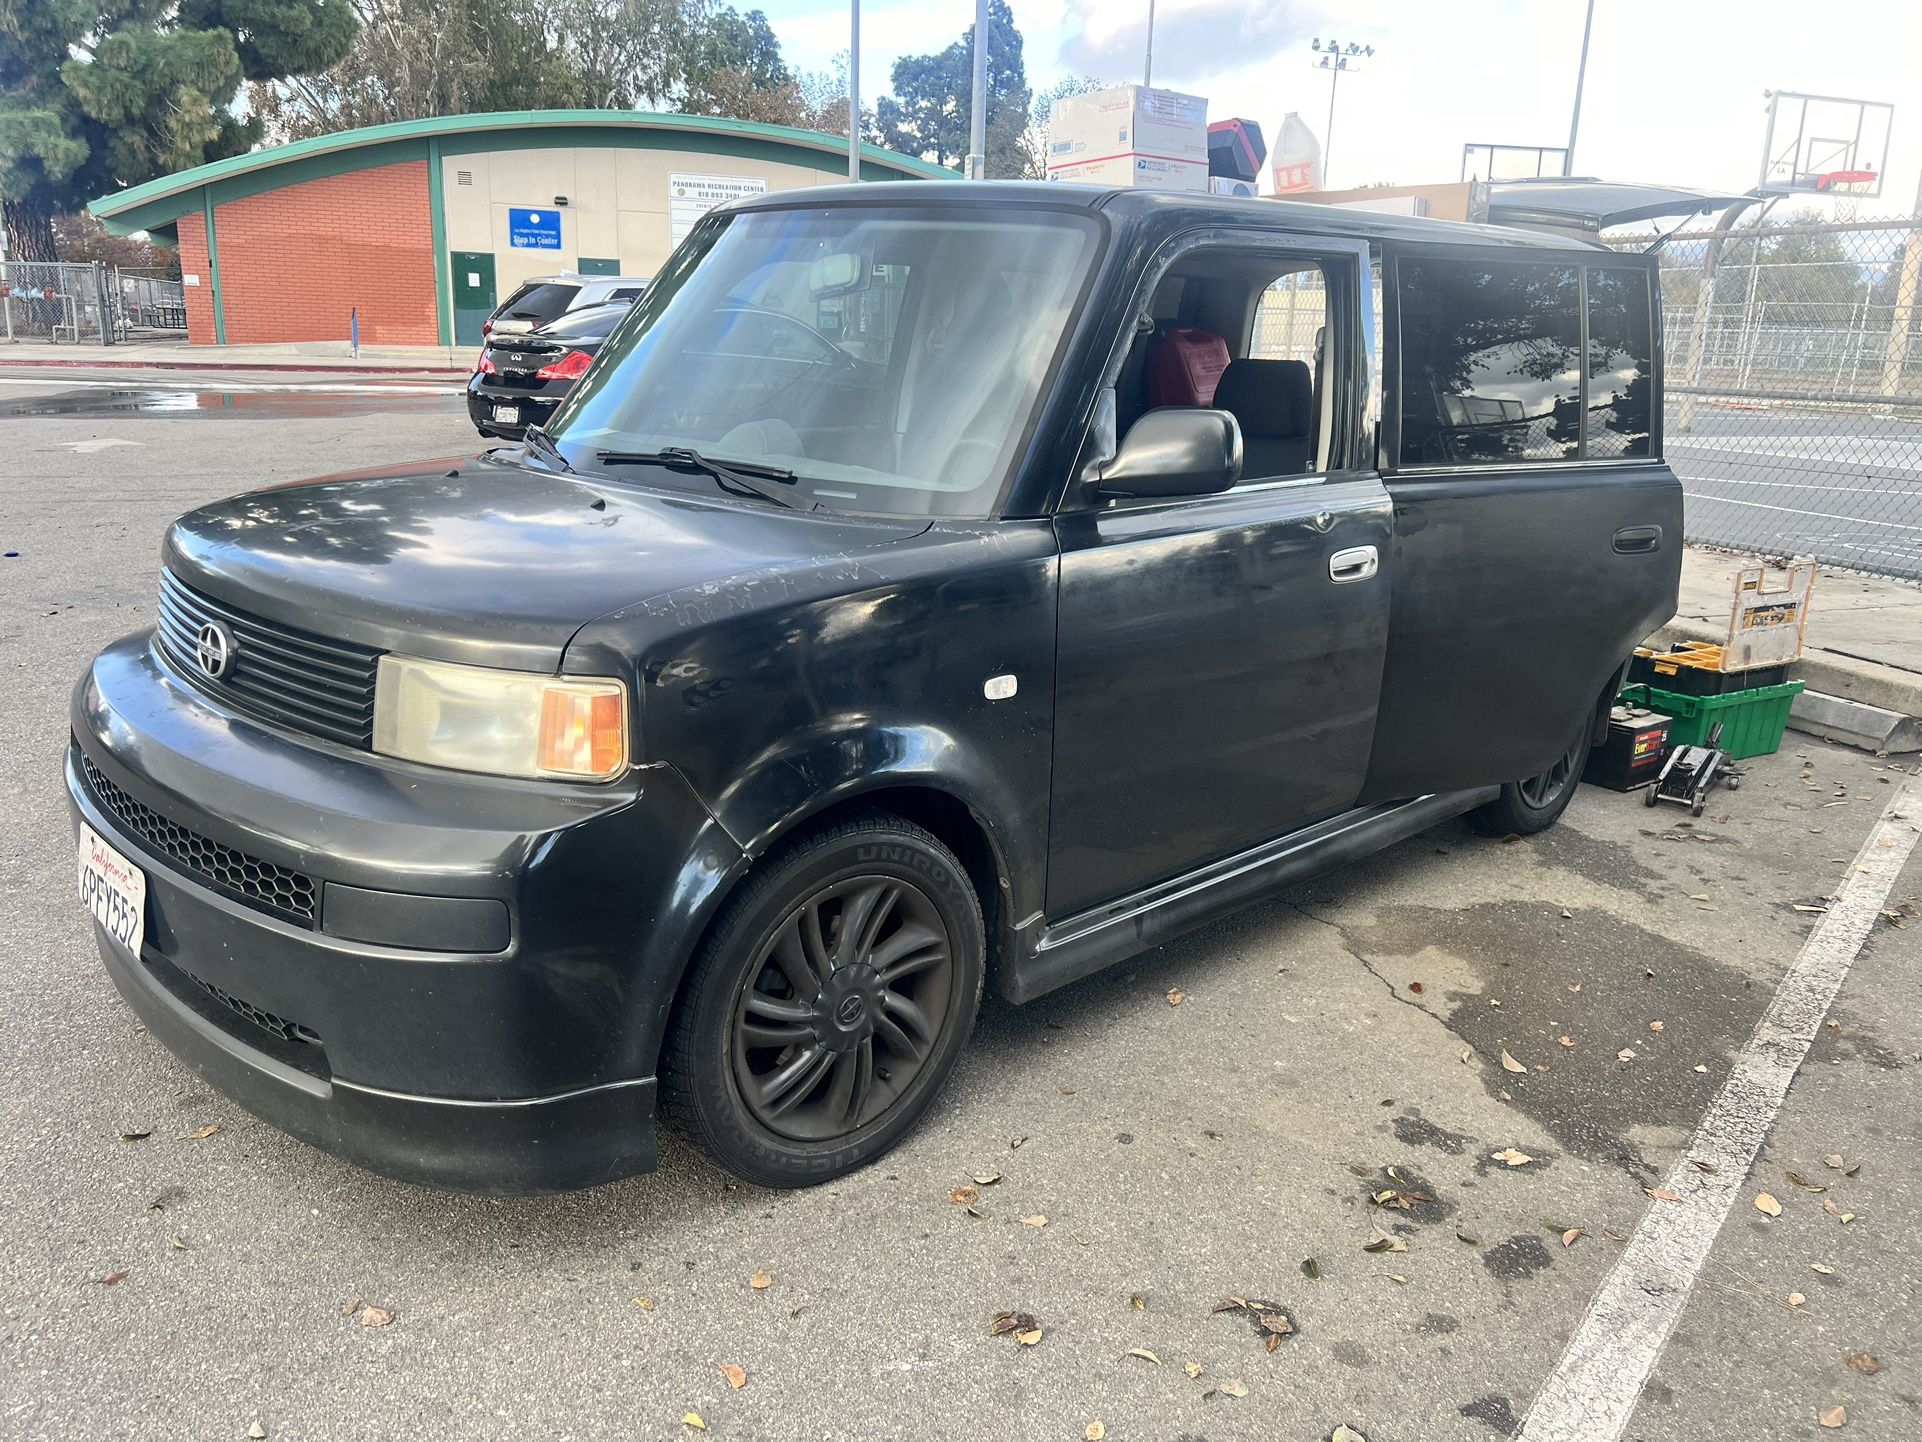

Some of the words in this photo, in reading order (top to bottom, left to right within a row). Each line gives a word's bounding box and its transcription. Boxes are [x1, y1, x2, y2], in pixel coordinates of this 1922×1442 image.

[672, 181, 705, 189] PANORAMA
[707, 183, 742, 191] RECREATION
[90, 841, 131, 891] California
[856, 845, 971, 928] UNIROYAL
[82, 865, 138, 953] 6PFY552
[765, 1148, 866, 1174] TIGER
